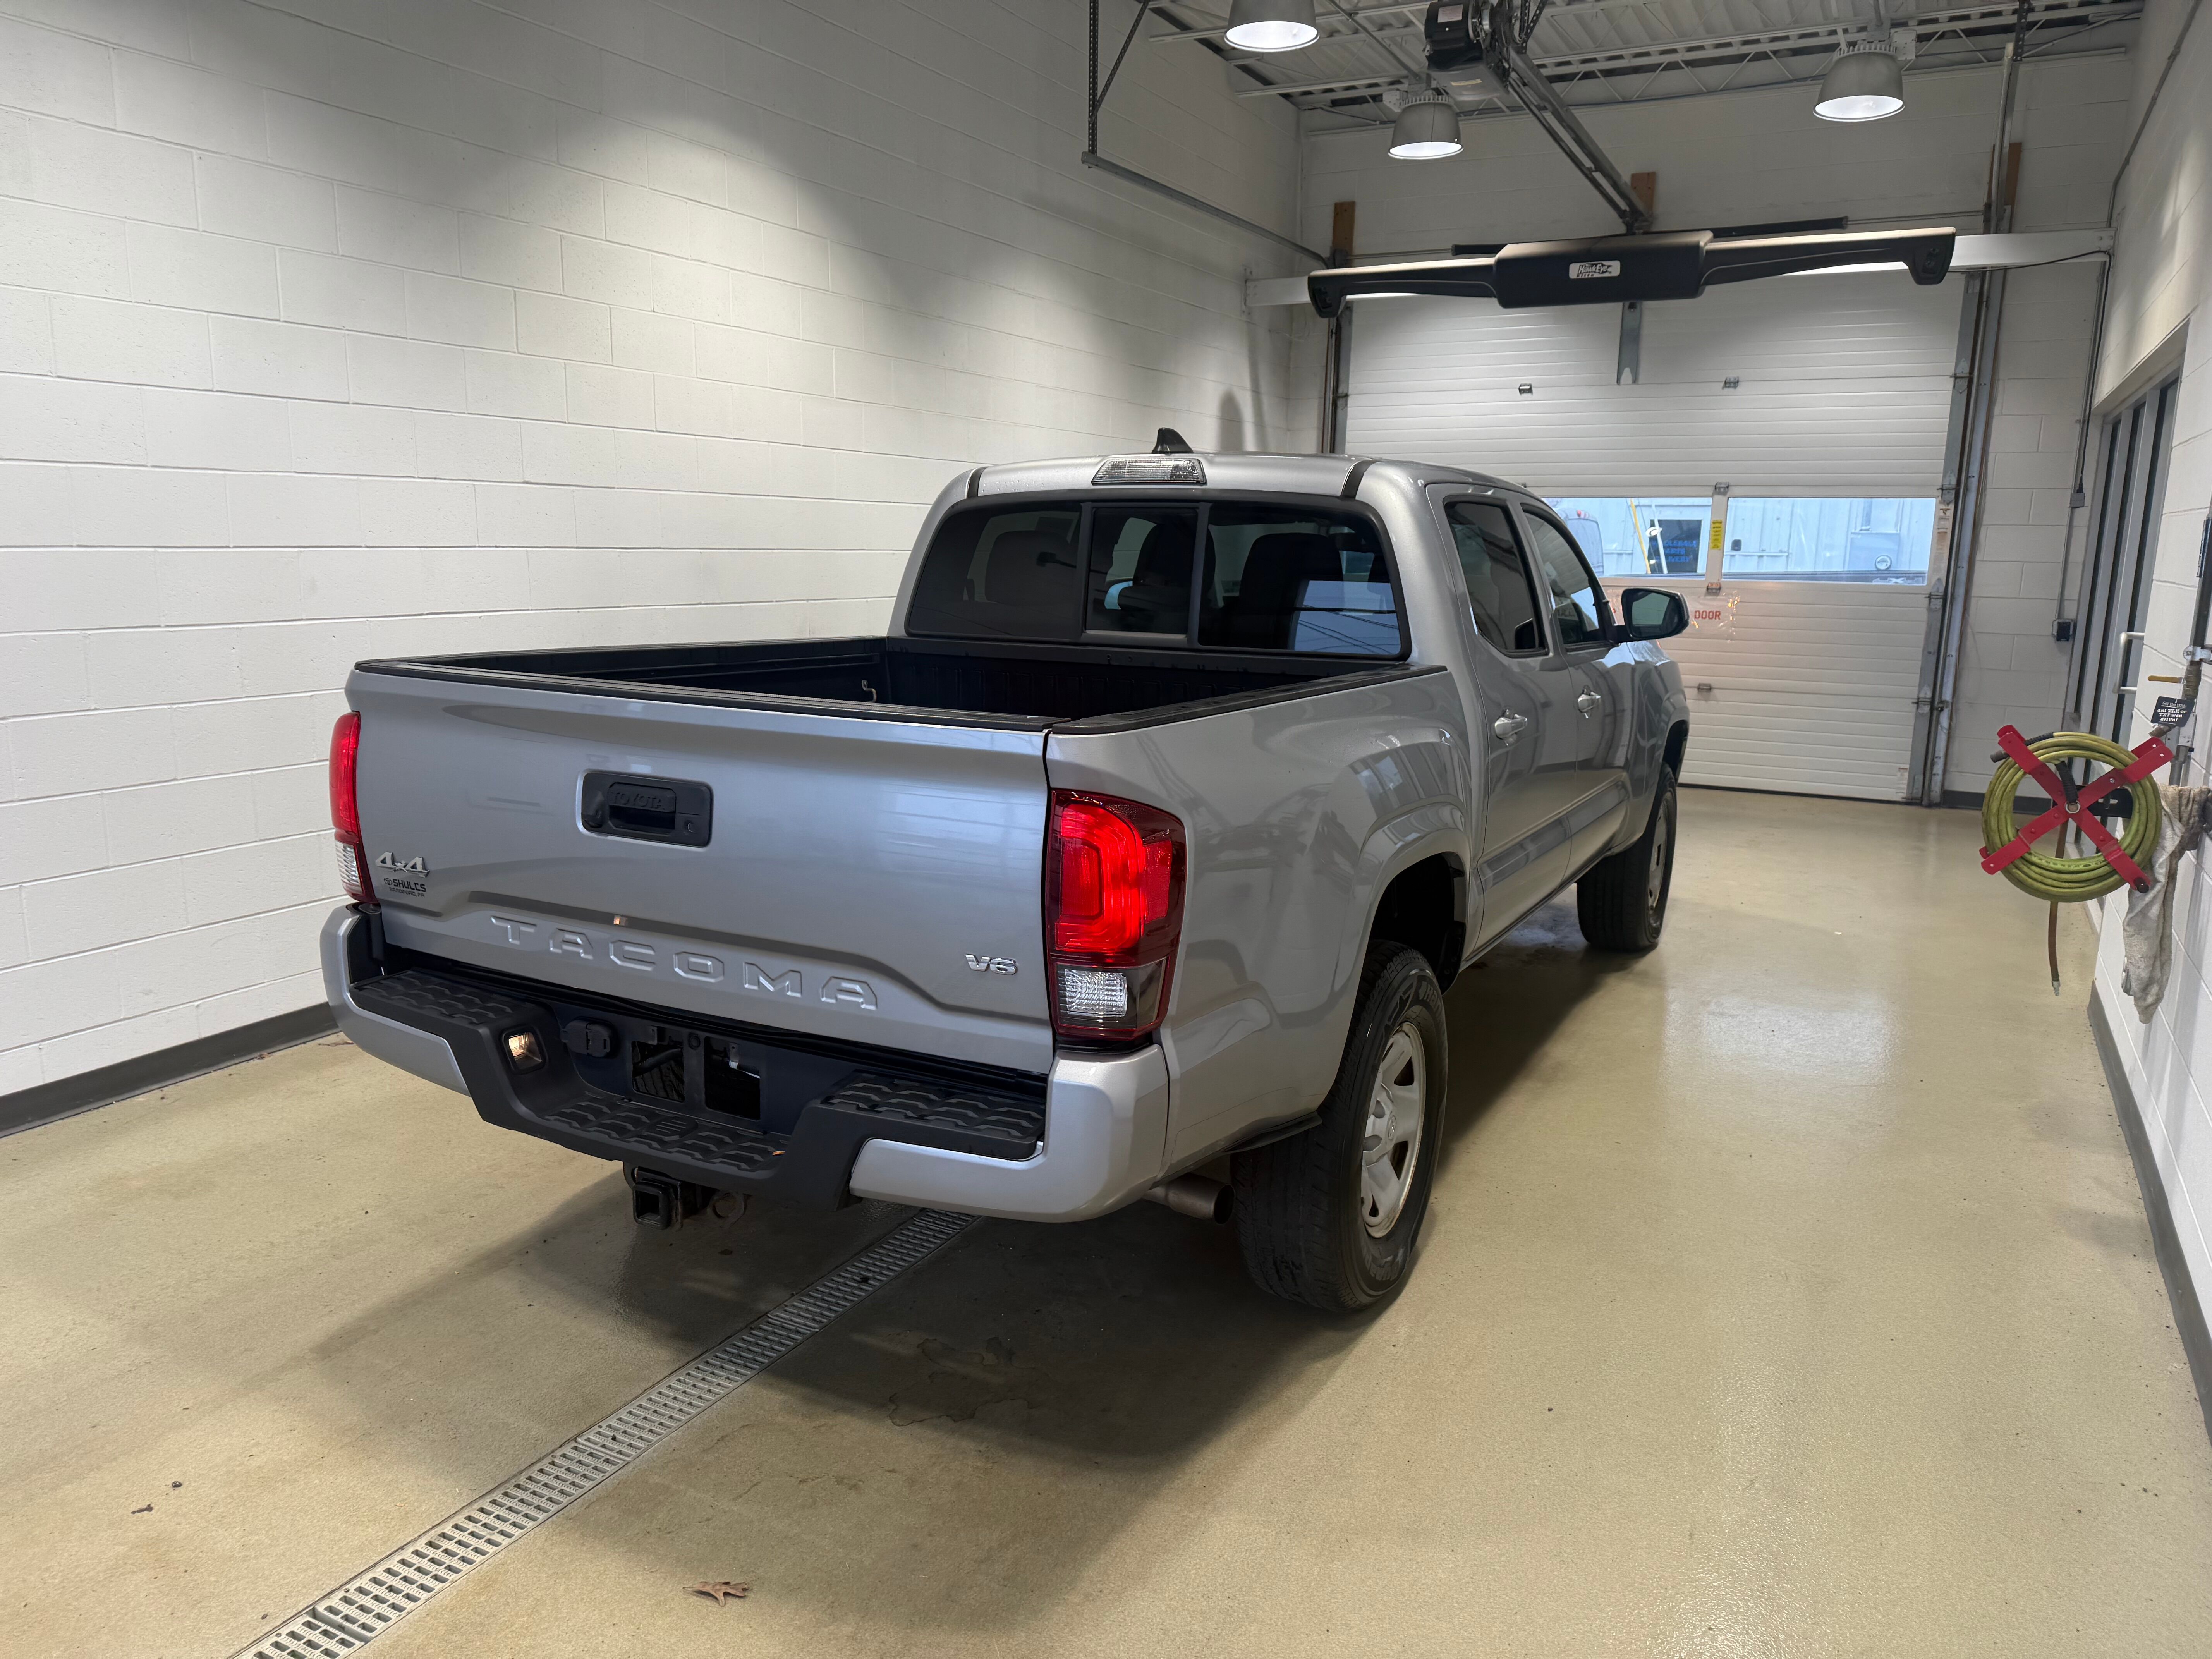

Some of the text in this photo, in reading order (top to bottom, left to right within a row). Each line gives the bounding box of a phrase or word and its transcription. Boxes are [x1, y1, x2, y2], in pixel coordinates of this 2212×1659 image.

[1578, 264, 1608, 274] HawkEye
[1695, 610, 1721, 620] DOOR
[608, 792, 665, 810] TOYOTA
[491, 915, 878, 1010] TACOMA
[965, 954, 1018, 975] V6
